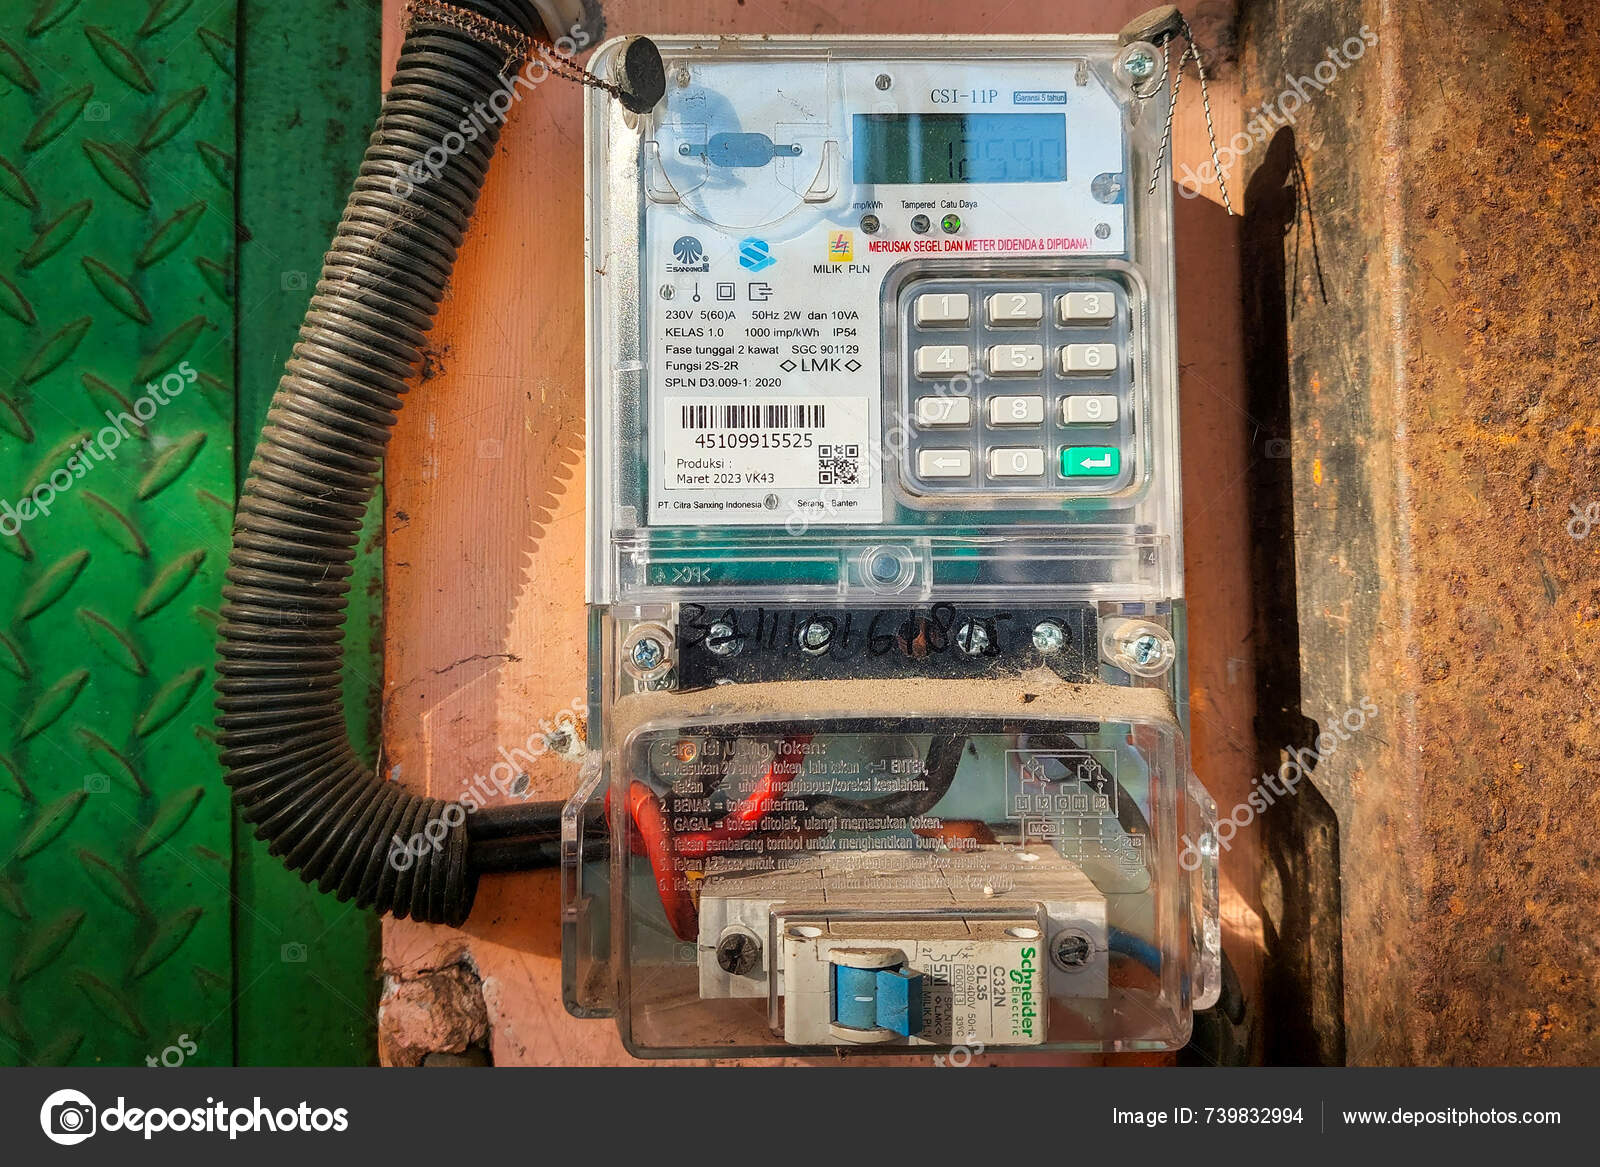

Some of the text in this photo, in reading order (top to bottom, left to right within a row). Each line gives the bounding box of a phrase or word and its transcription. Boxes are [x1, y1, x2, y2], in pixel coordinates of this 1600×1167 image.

[930, 89, 998, 104] CSI-11P
[1015, 93, 1066, 103] Garansi 5 tahun
[852, 200, 884, 210] imp/kWh
[901, 199, 978, 209] Tampered Catu Daya
[868, 241, 912, 253] MERUSAK
[914, 240, 943, 252] SEGEL
[945, 240, 963, 251] DAN
[965, 240, 996, 251] METER
[998, 239, 1037, 251] DIDENDA
[1039, 239, 1045, 249] &
[1047, 238, 1088, 249] DIPIDANA
[813, 265, 870, 274] MILIK PLN
[941, 294, 1100, 317] 1 2 3
[665, 310, 859, 321] 230V 5(60)A 50Hz 2W dan 10VA
[665, 328, 857, 339] KELAS 1.0 1000 imp/kWh IP54
[665, 345, 859, 357] Fase tunggal 2 kawat SGC 901129
[936, 346, 1101, 368] 4 5 6
[665, 361, 739, 373] Fungsi 2S-2R
[801, 358, 842, 372] LMK
[665, 378, 782, 388] SPLN D3.009-1: 2020
[1012, 399, 1028, 420] 8
[1086, 399, 1102, 419] 9
[695, 433, 813, 449] 45109915525
[677, 459, 725, 469] Produksi
[1012, 452, 1028, 472] 0
[677, 473, 775, 484] Maret 2023 VK43
[658, 501, 762, 510] PT. Citra Sanxing Indonesia
[797, 499, 824, 508] Serang
[831, 499, 858, 507] Banten
[774, 739, 827, 756] Token:
[773, 761, 806, 777] token,
[808, 760, 828, 774] lalu
[890, 759, 929, 776] ENTER,
[771, 778, 871, 796] menghapus/koreksi
[873, 777, 929, 792] kesalahan.
[659, 799, 670, 813] 2.
[673, 799, 712, 812] BENAR
[726, 798, 758, 812] token
[760, 798, 808, 812] diterima.
[673, 816, 712, 831] GAGAL
[726, 816, 758, 831] token
[760, 816, 801, 832] ditolak,
[804, 816, 838, 832] ulangi
[840, 816, 907, 830] memasukan
[909, 815, 944, 830] token.
[1031, 824, 1056, 833] MCB
[672, 837, 704, 851] Tekan
[706, 836, 764, 853] sembarang
[766, 835, 803, 850] tombol
[806, 835, 836, 850] untuk
[838, 835, 913, 852] menghentikan
[915, 834, 945, 851] bunyi
[946, 834, 981, 849] alarm.
[933, 964, 948, 986] SNI
[976, 964, 988, 1001] CL35
[993, 965, 1007, 1008] C32N
[1021, 947, 1037, 1038] Schneider
[966, 964, 977, 1036] 230/400V 50Hz
[1011, 985, 1021, 1037] Electric
